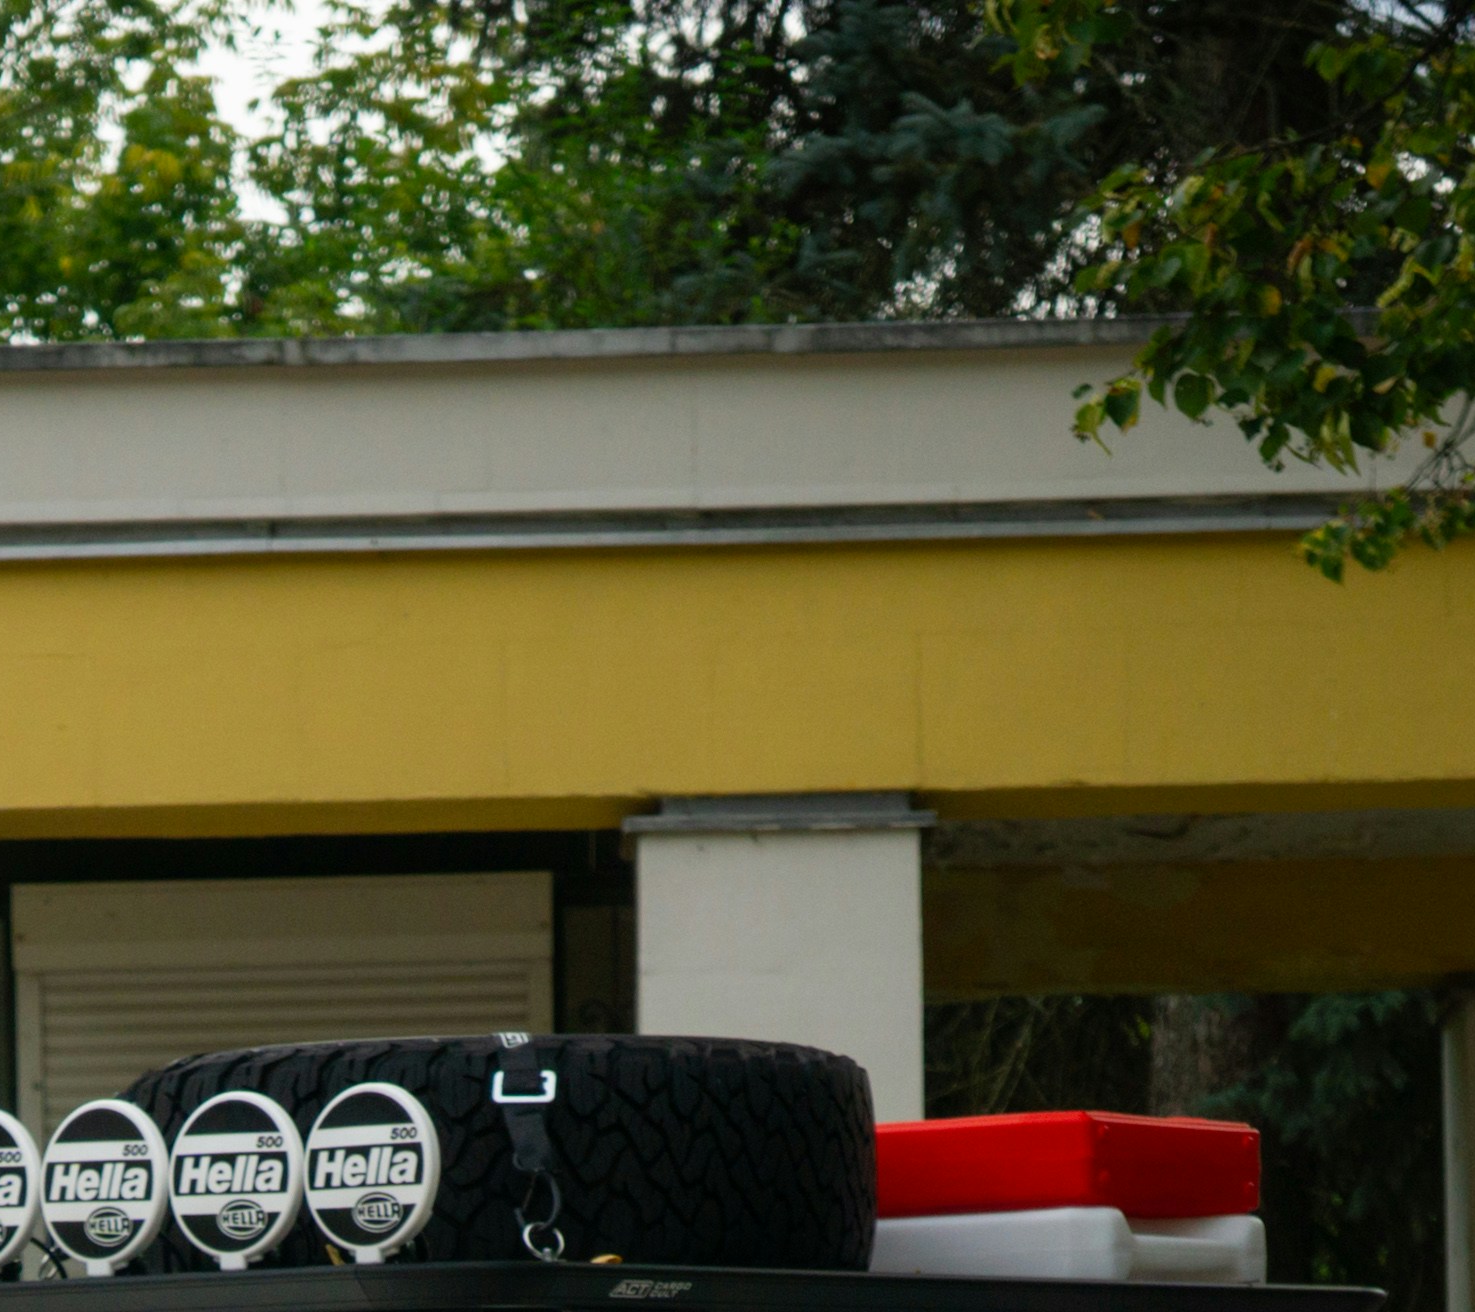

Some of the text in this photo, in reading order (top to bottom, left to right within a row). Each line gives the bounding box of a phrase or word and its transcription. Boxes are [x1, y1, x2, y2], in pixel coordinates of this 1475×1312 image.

[256, 1135, 284, 1149] 500
[390, 1126, 418, 1140] 500
[123, 1144, 148, 1157] 500
[178, 1154, 284, 1195] Hella
[314, 1146, 419, 1188] Hella
[49, 1162, 149, 1201] Hella
